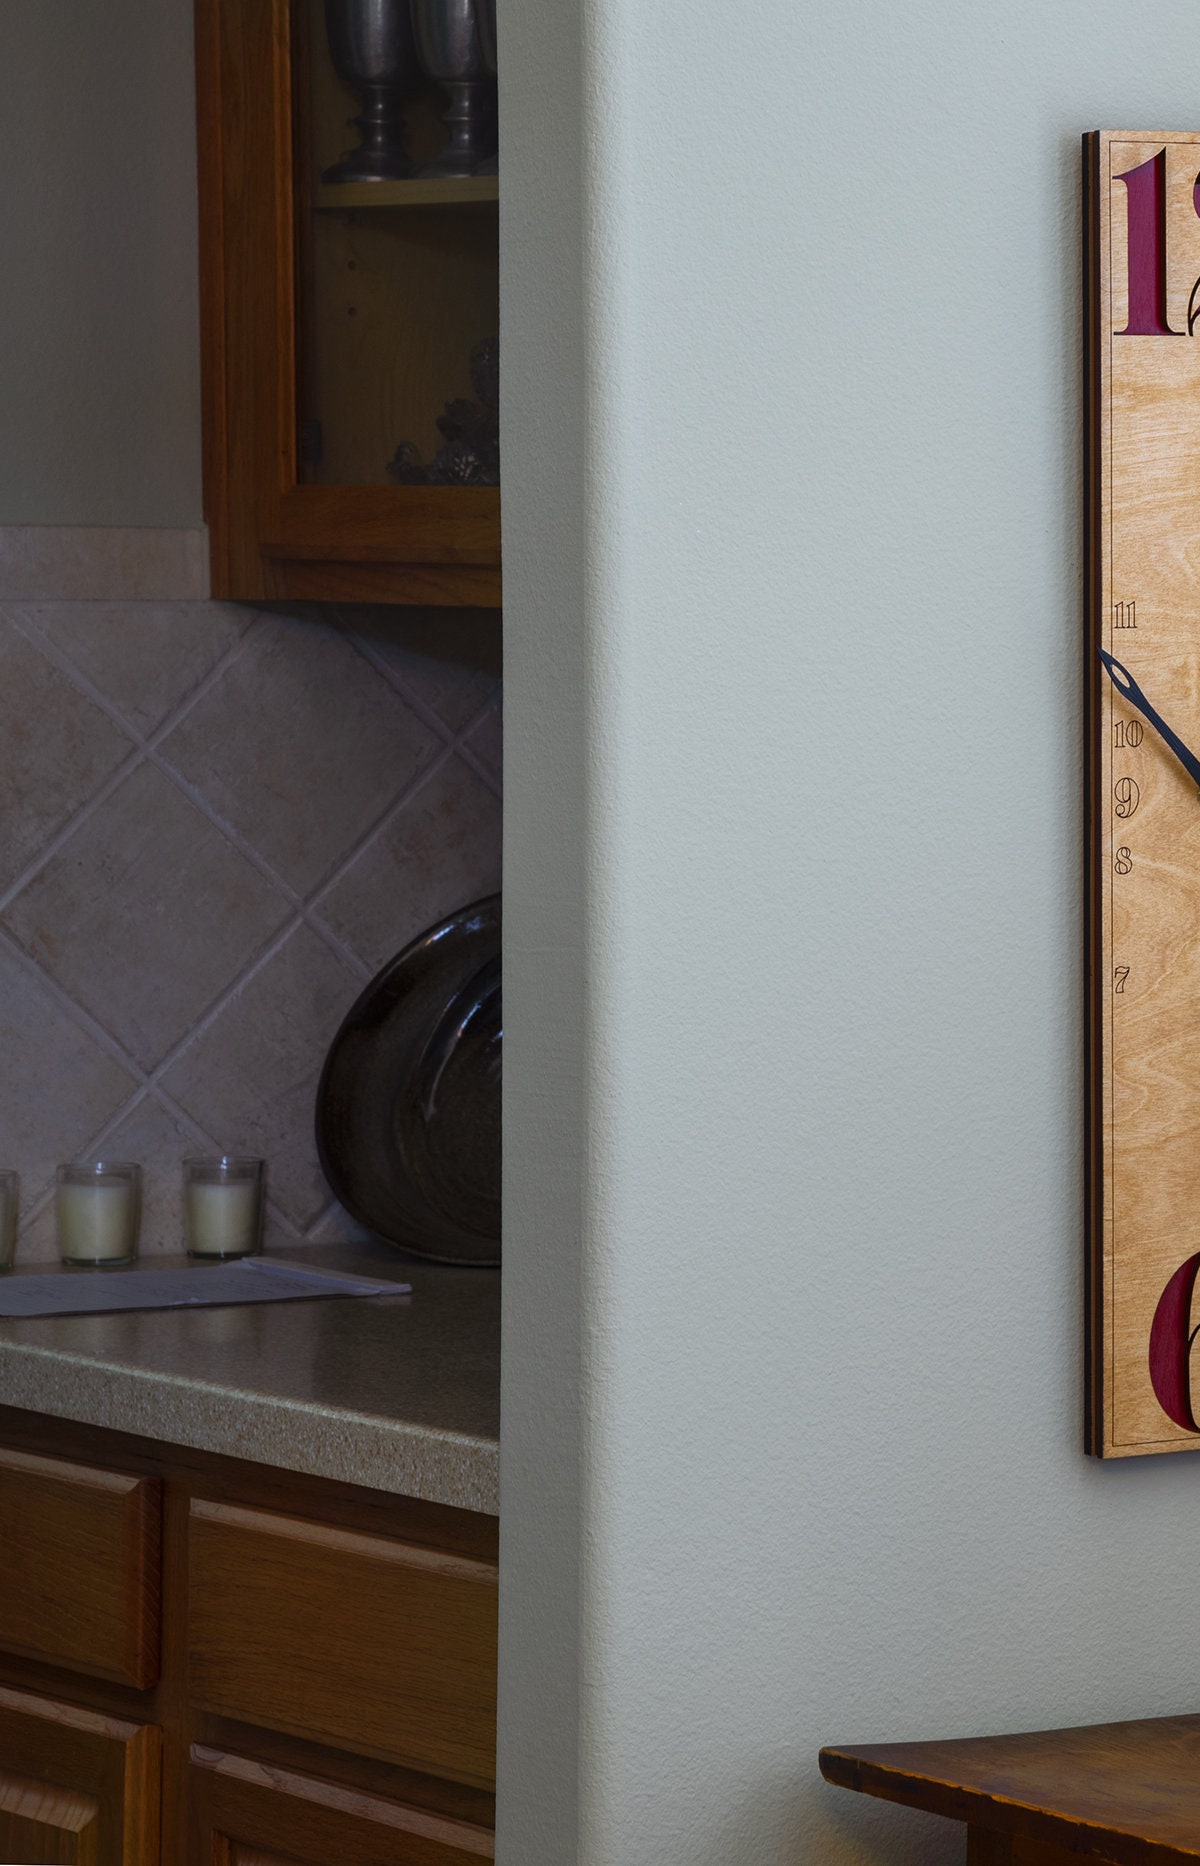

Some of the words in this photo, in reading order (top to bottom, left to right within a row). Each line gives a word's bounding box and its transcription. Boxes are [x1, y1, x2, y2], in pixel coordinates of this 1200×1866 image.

[1114, 601, 1138, 628] 11
[1114, 720, 1144, 748] 10
[1114, 777, 1140, 818] 9
[1114, 847, 1133, 875] 8
[1114, 966, 1130, 994] 7
